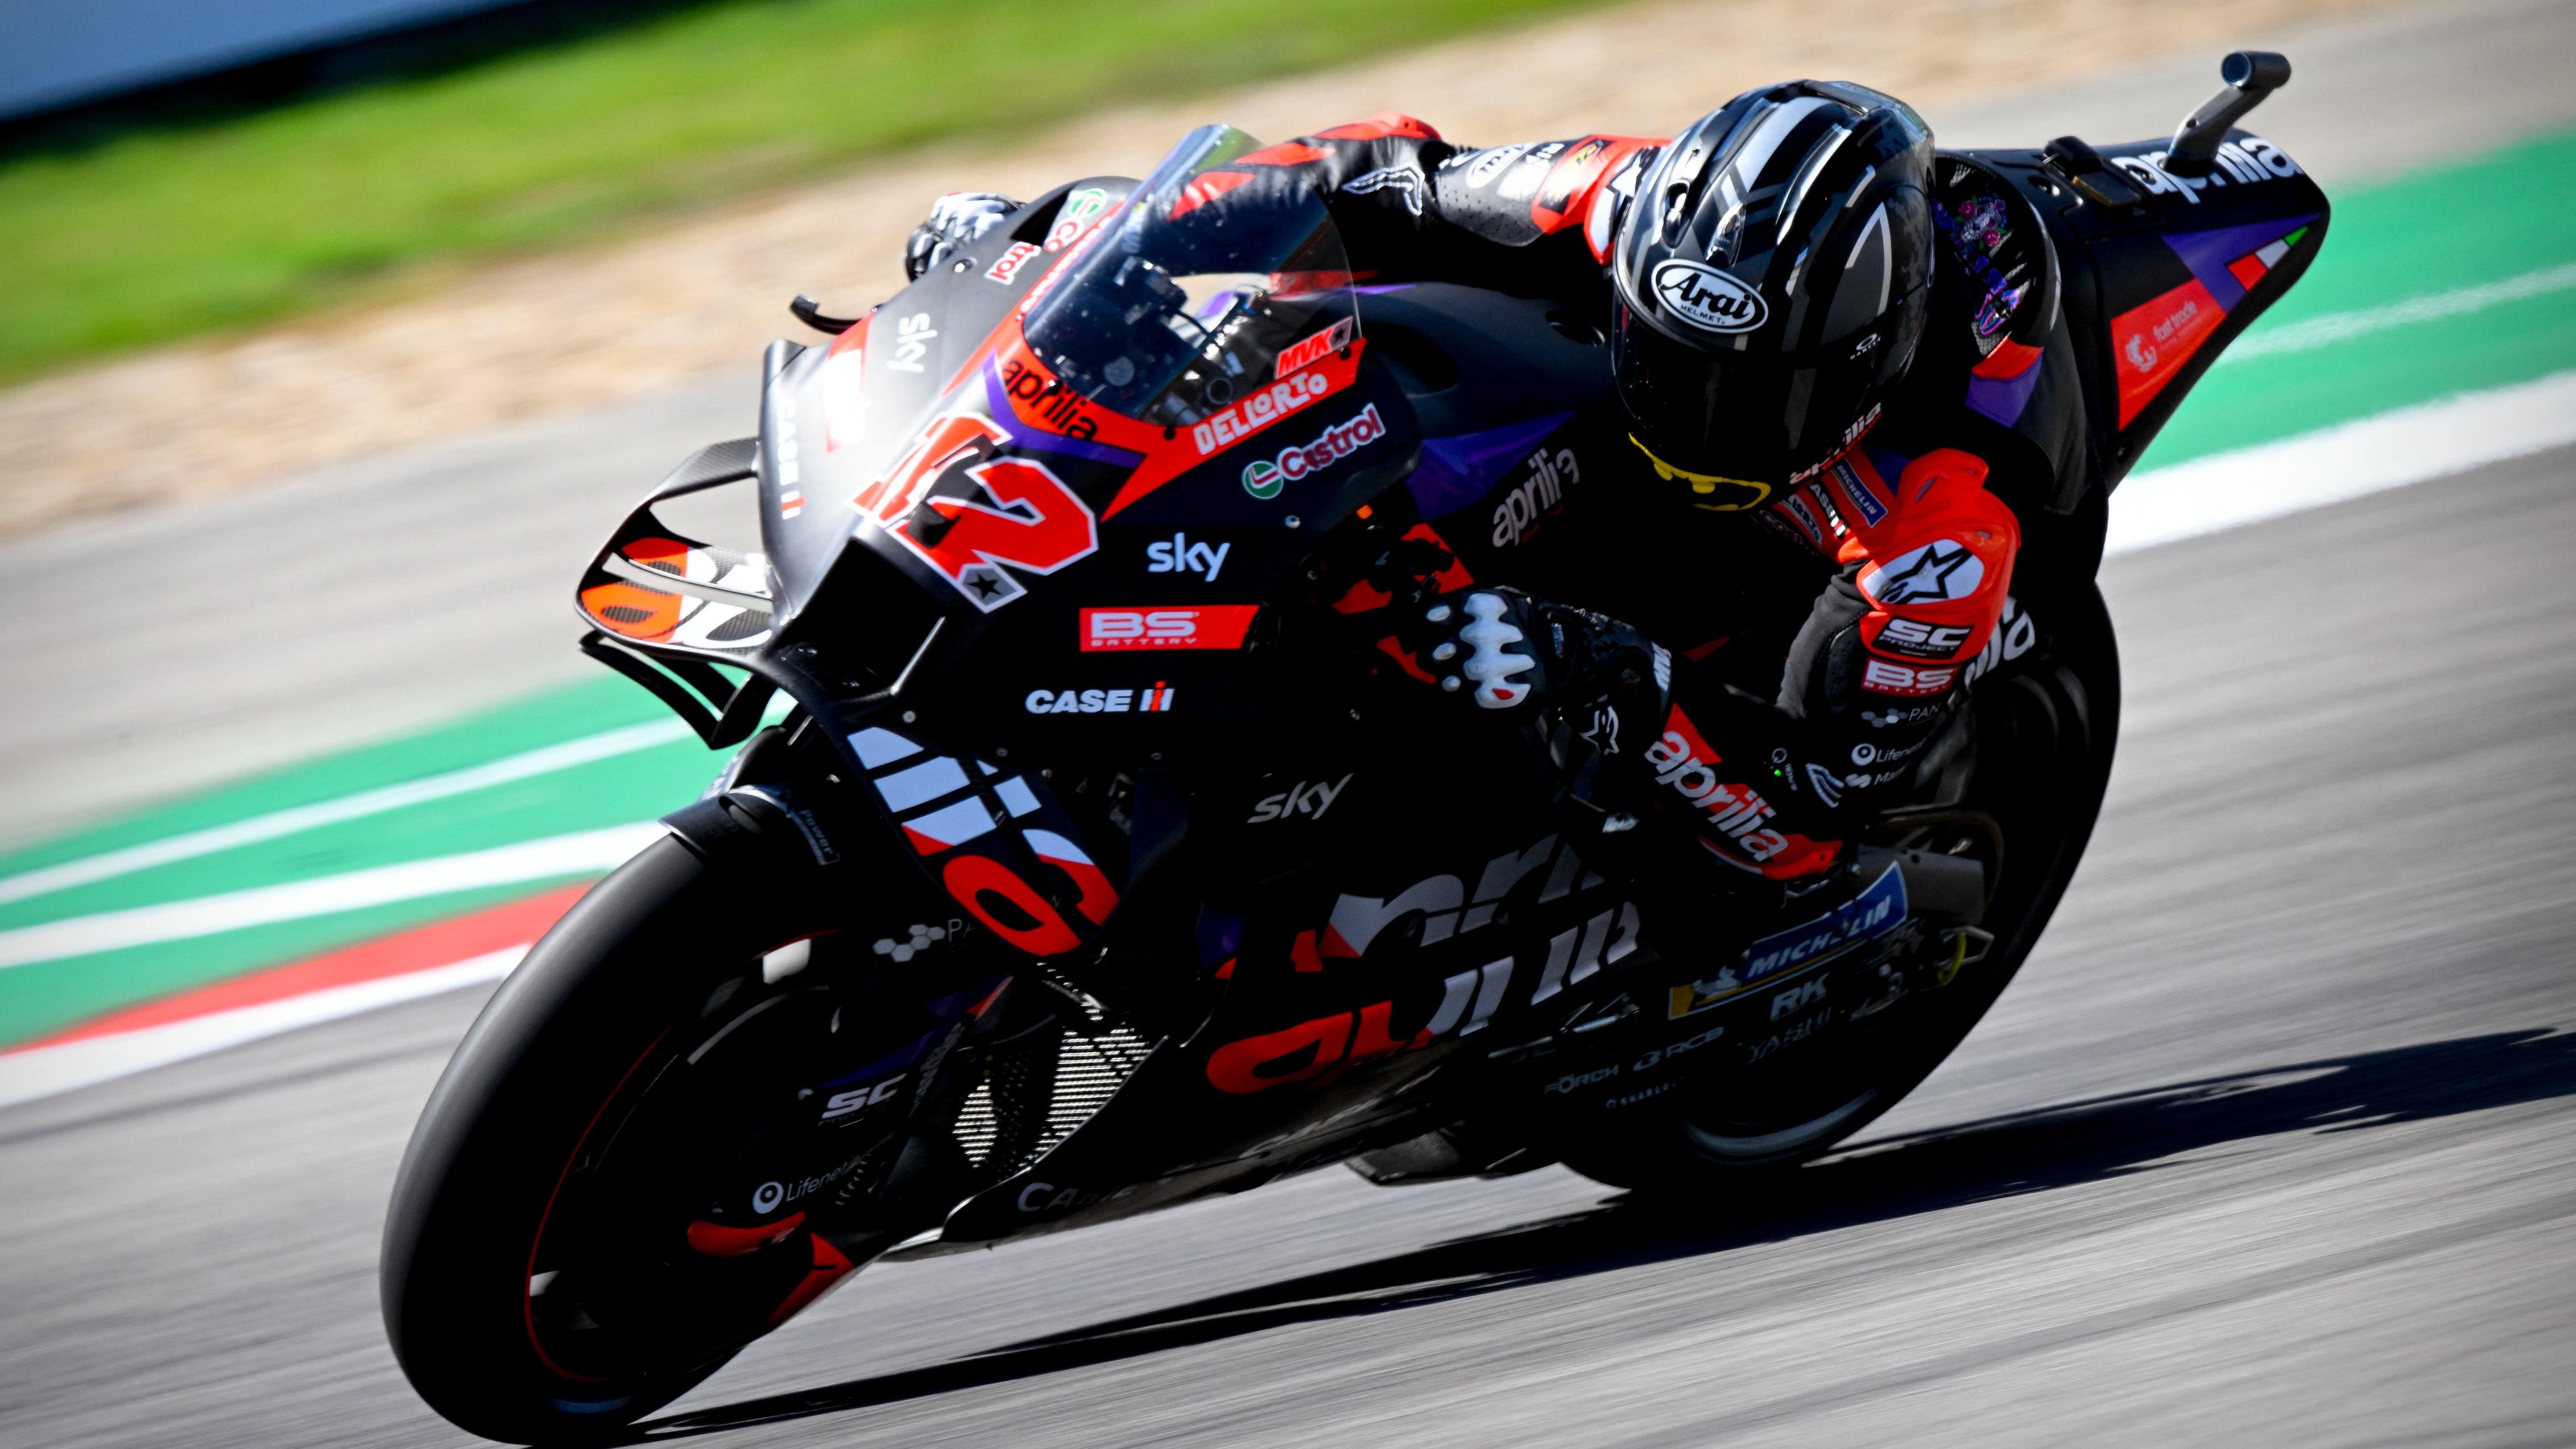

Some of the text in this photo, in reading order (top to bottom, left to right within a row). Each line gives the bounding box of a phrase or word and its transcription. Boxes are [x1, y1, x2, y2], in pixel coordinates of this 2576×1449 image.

[1658, 271, 1754, 319] Arai
[1680, 305, 1723, 323] HELMET
[886, 314, 938, 373] sky
[1275, 327, 1334, 379] MVK
[1001, 359, 1097, 440] aprilia
[1277, 402, 1386, 480] Castrol
[1492, 448, 1580, 546] aprilia
[1809, 483, 1837, 518] ASE
[1836, 464, 1879, 515] MICHELIN
[1148, 533, 1230, 582] sky
[1091, 611, 1197, 638] BS
[1091, 638, 1197, 647] BATTERY
[1883, 618, 1969, 646] SC
[1866, 659, 1954, 690] BS
[1026, 689, 1133, 714] CASE
[1247, 772, 1355, 824] sky
[1644, 731, 1789, 862] aprilia
[1747, 895, 1892, 979] MICHLIN
[820, 1072, 907, 1119] SC
